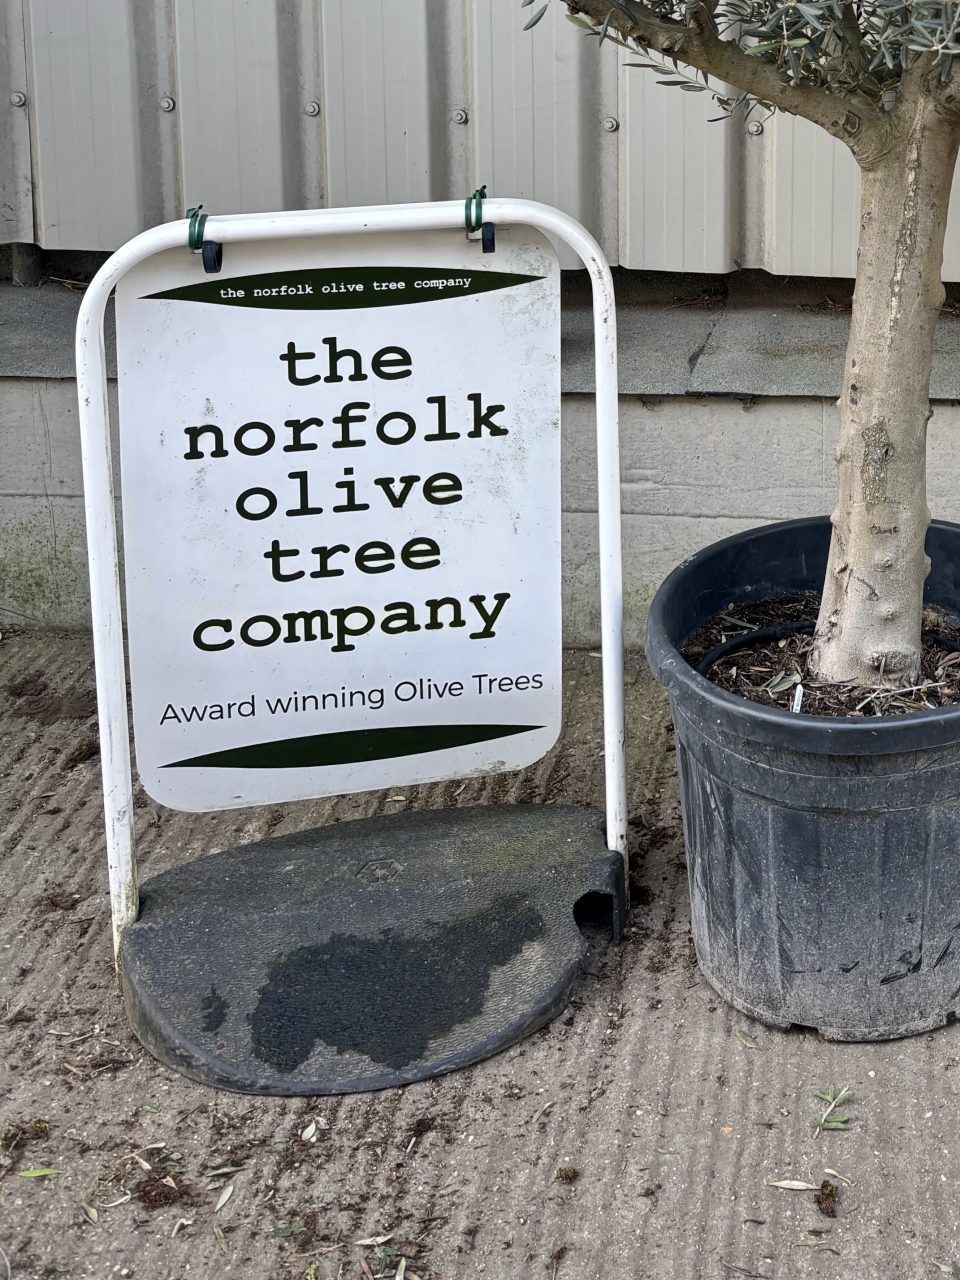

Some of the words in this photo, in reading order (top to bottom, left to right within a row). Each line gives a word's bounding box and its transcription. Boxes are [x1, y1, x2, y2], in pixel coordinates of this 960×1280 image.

[219, 287, 246, 300] the
[252, 283, 315, 298] norfolk
[321, 281, 365, 295] olive
[371, 280, 407, 292] tree
[412, 277, 473, 291] company
[279, 336, 413, 387] the
[183, 392, 509, 461] norfolk
[235, 466, 463, 521] olive
[263, 536, 441, 583] tree
[192, 592, 511, 653] company
[158, 693, 257, 726] Award
[264, 686, 386, 716] winning
[393, 677, 465, 703] Olive
[470, 672, 544, 696] Trees
